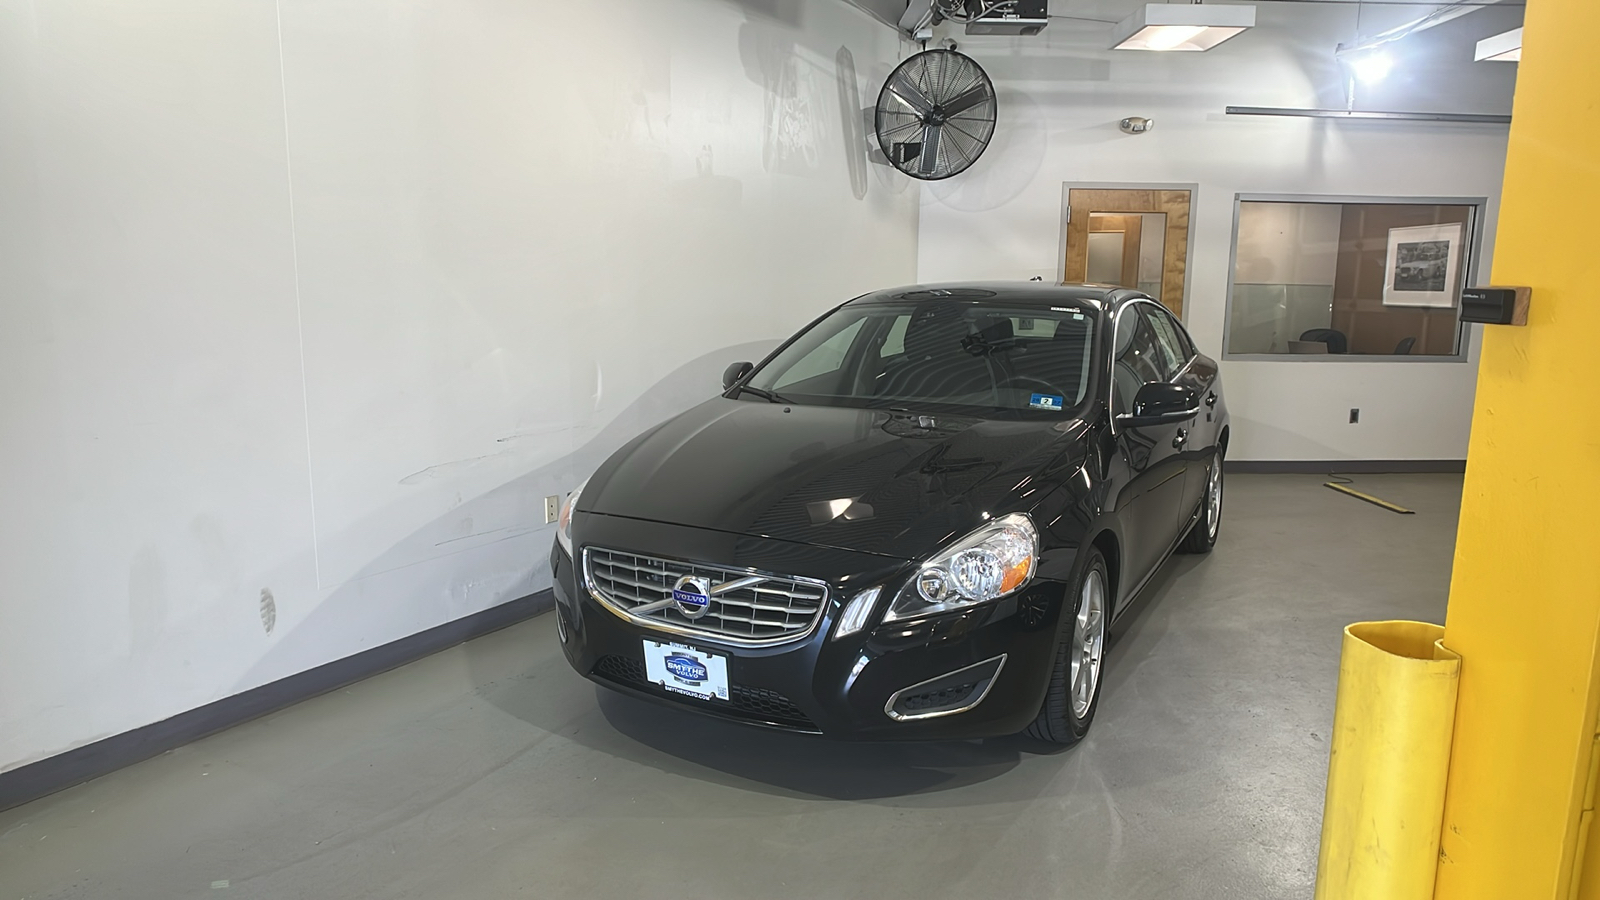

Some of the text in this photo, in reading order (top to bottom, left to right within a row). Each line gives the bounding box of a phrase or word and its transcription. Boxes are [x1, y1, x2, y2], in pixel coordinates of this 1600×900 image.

[674, 592, 706, 603] VOLVO
[667, 662, 706, 677] SMYTHE
[676, 669, 699, 679] VOLVO
